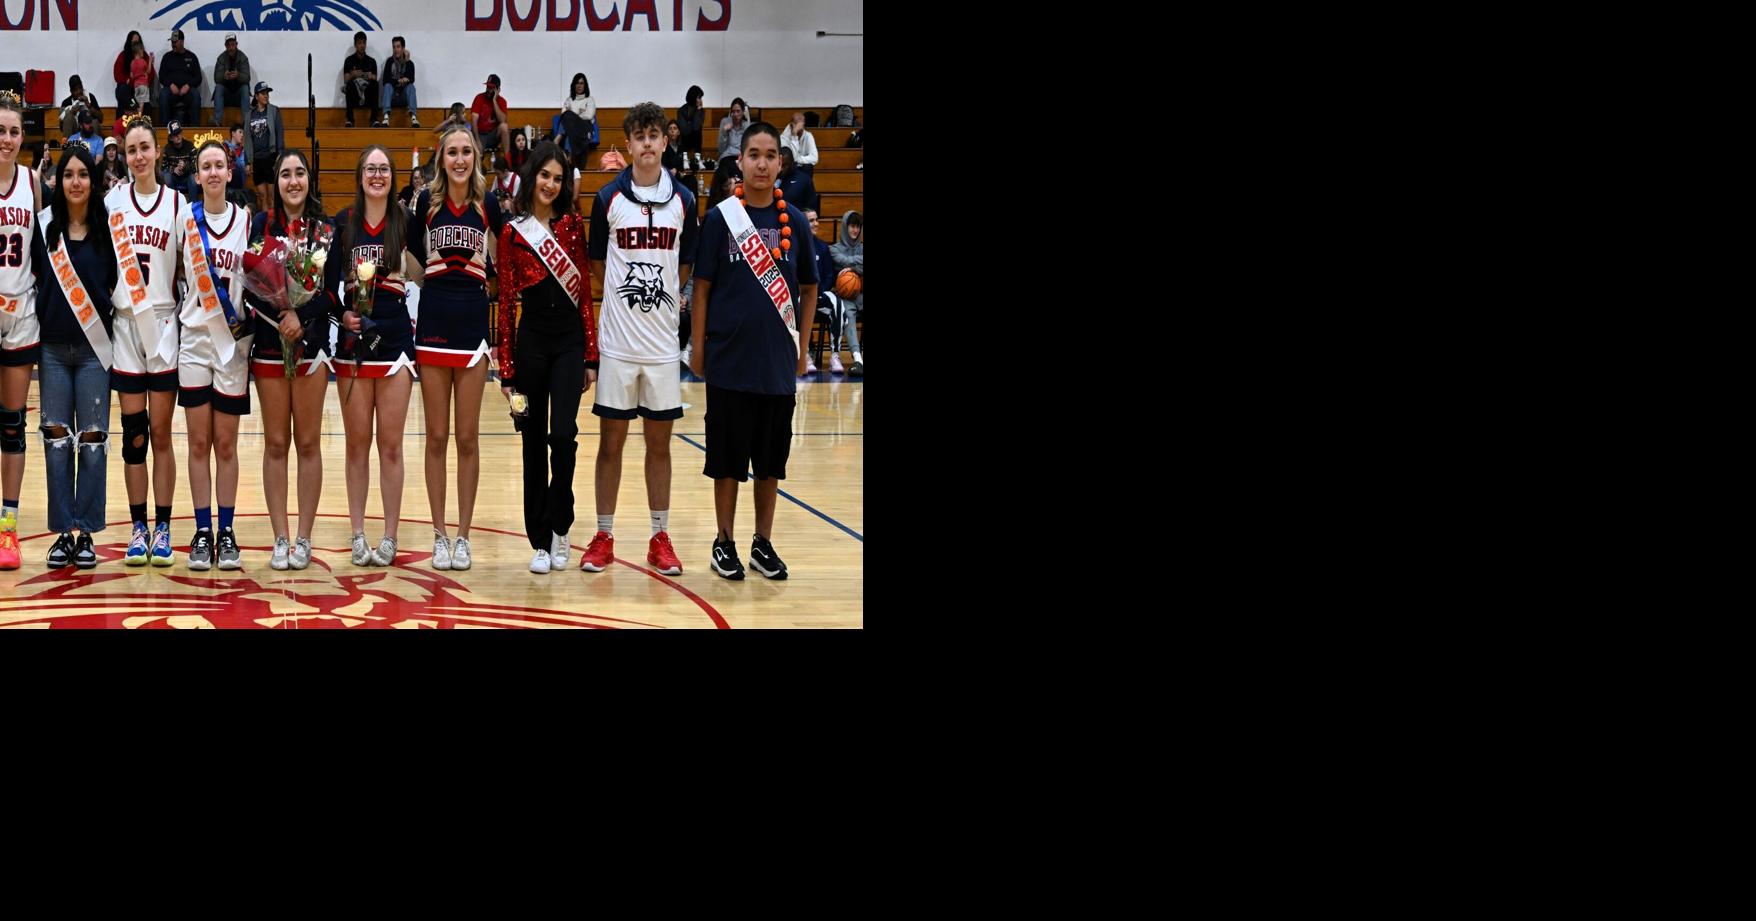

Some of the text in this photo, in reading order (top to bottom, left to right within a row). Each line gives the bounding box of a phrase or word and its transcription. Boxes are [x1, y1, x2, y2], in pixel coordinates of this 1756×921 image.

[465, 0, 731, 31] BOBCATS
[430, 225, 484, 253] BOBCATS
[616, 226, 677, 250] BENSON
[760, 265, 780, 288] 2025
